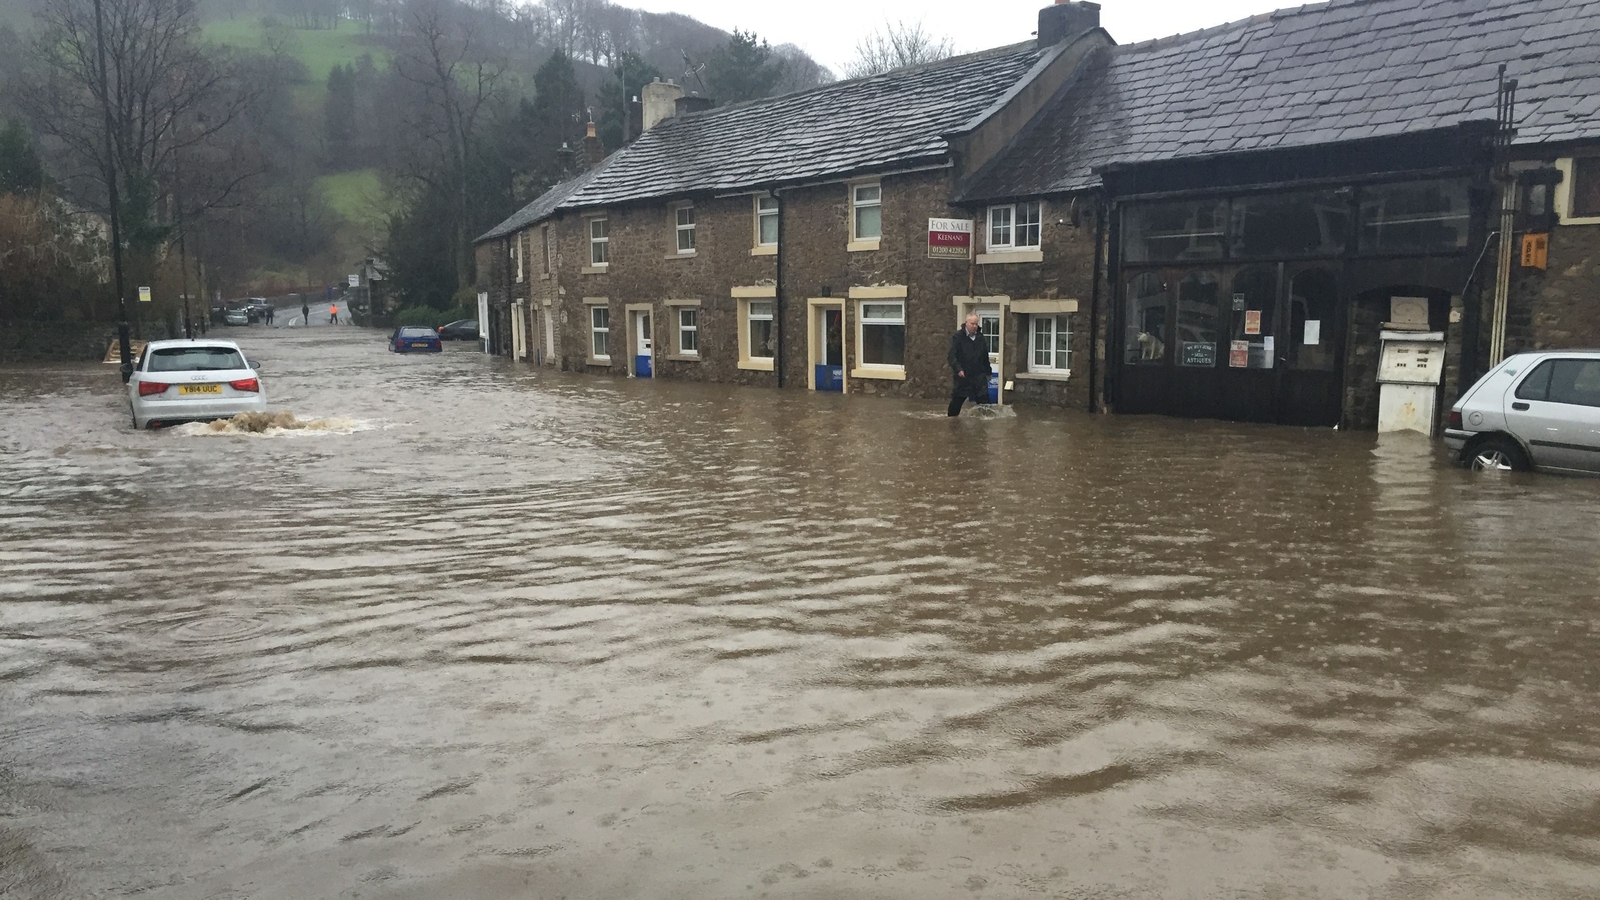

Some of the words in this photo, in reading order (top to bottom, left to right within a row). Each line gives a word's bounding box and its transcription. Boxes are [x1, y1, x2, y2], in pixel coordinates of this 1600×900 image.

[931, 220, 948, 230] FOR
[951, 221, 969, 231] SALE
[937, 233, 963, 241] KEENANS
[932, 246, 948, 254] 01200
[203, 385, 218, 393] UUC
